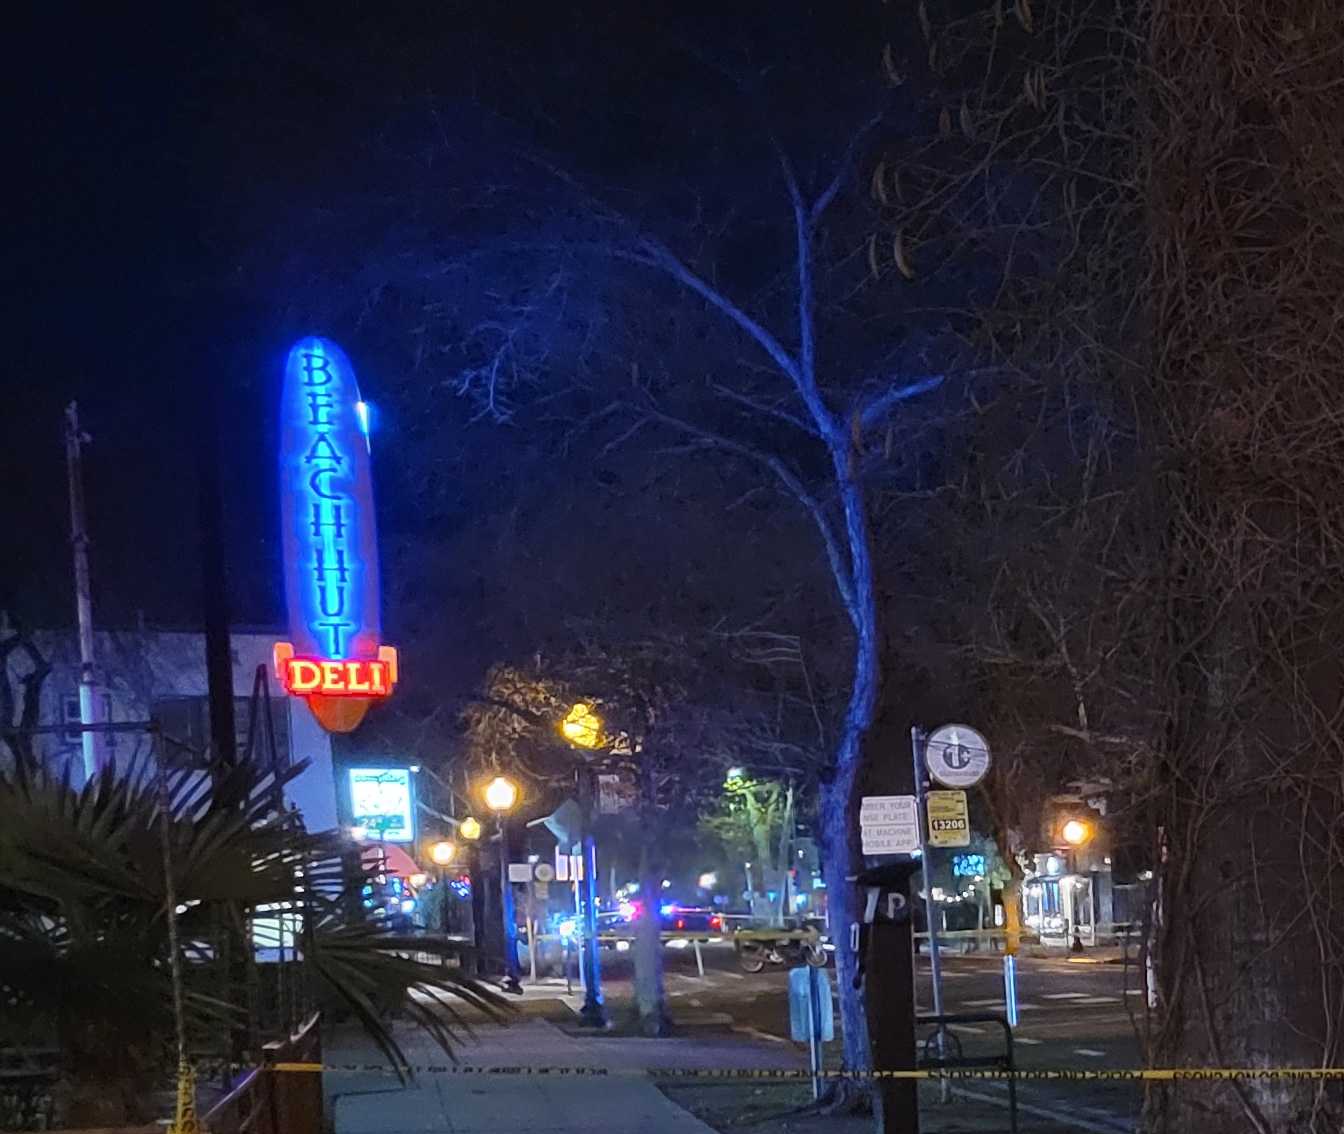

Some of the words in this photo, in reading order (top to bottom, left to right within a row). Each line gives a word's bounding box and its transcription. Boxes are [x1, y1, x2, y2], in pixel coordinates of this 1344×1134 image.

[302, 352, 347, 539] BEACH
[313, 547, 354, 658] HUT
[289, 658, 388, 692] DELI
